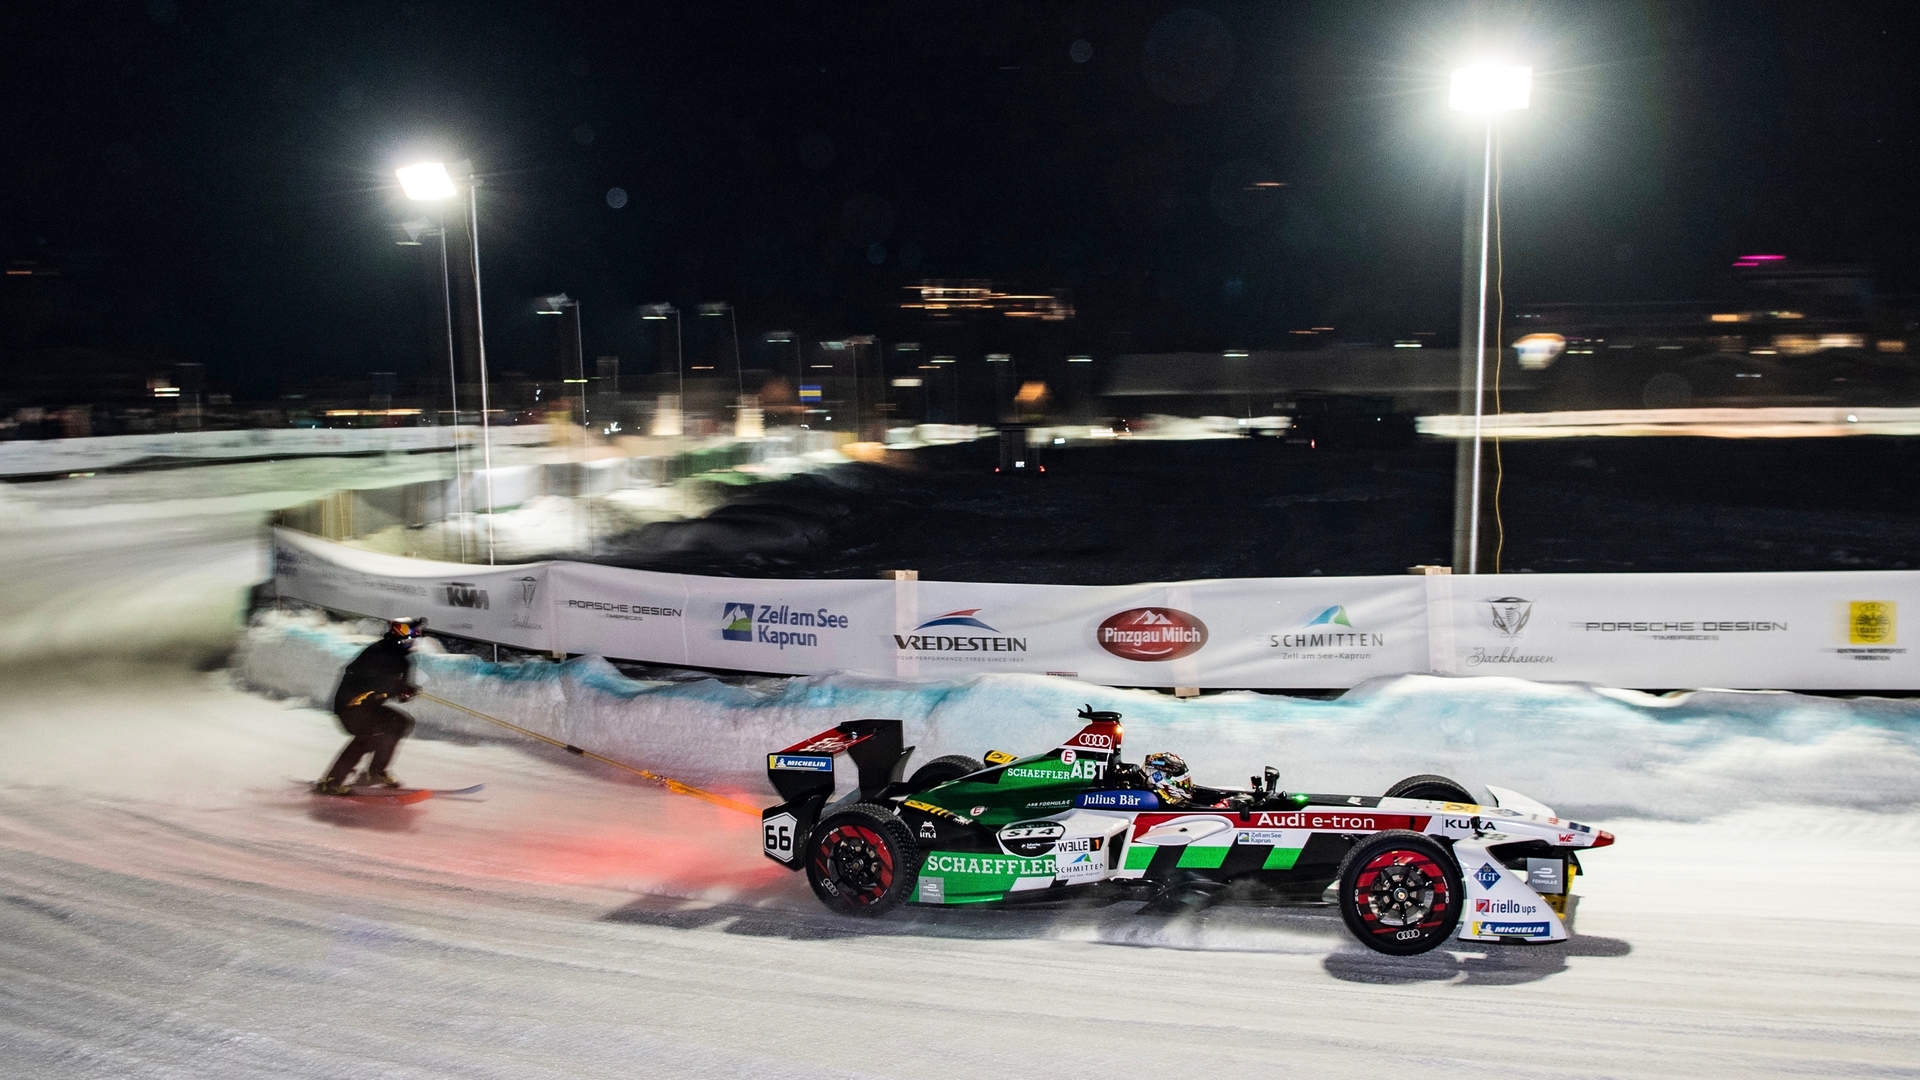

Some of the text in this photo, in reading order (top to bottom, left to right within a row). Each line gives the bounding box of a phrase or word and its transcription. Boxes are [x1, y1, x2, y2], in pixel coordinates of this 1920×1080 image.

[569, 600, 682, 617] PORSCHE DESIGN
[757, 605, 849, 628] Zell am See
[1586, 621, 1788, 632] PORSCHE DESIGN
[758, 625, 817, 650] Kaprun
[893, 635, 1027, 652] VREDESTEIN
[1105, 627, 1201, 646] Pinzgau Milch
[1270, 633, 1384, 647] SCHMITTEN
[1466, 647, 1557, 667] Backhausen
[787, 760, 827, 768] MICHELIN
[1070, 760, 1108, 780] ABT
[1007, 768, 1070, 780] SCHAEFFLER
[1084, 794, 1141, 806] Julius Bär
[1257, 813, 1375, 828] Audi e-tron
[765, 825, 792, 851] 66
[927, 855, 1056, 875] SCHAEFFLER
[1056, 863, 1104, 873] SCHMITTEN
[1478, 872, 1497, 881] LGT
[1491, 900, 1536, 916] riello ups
